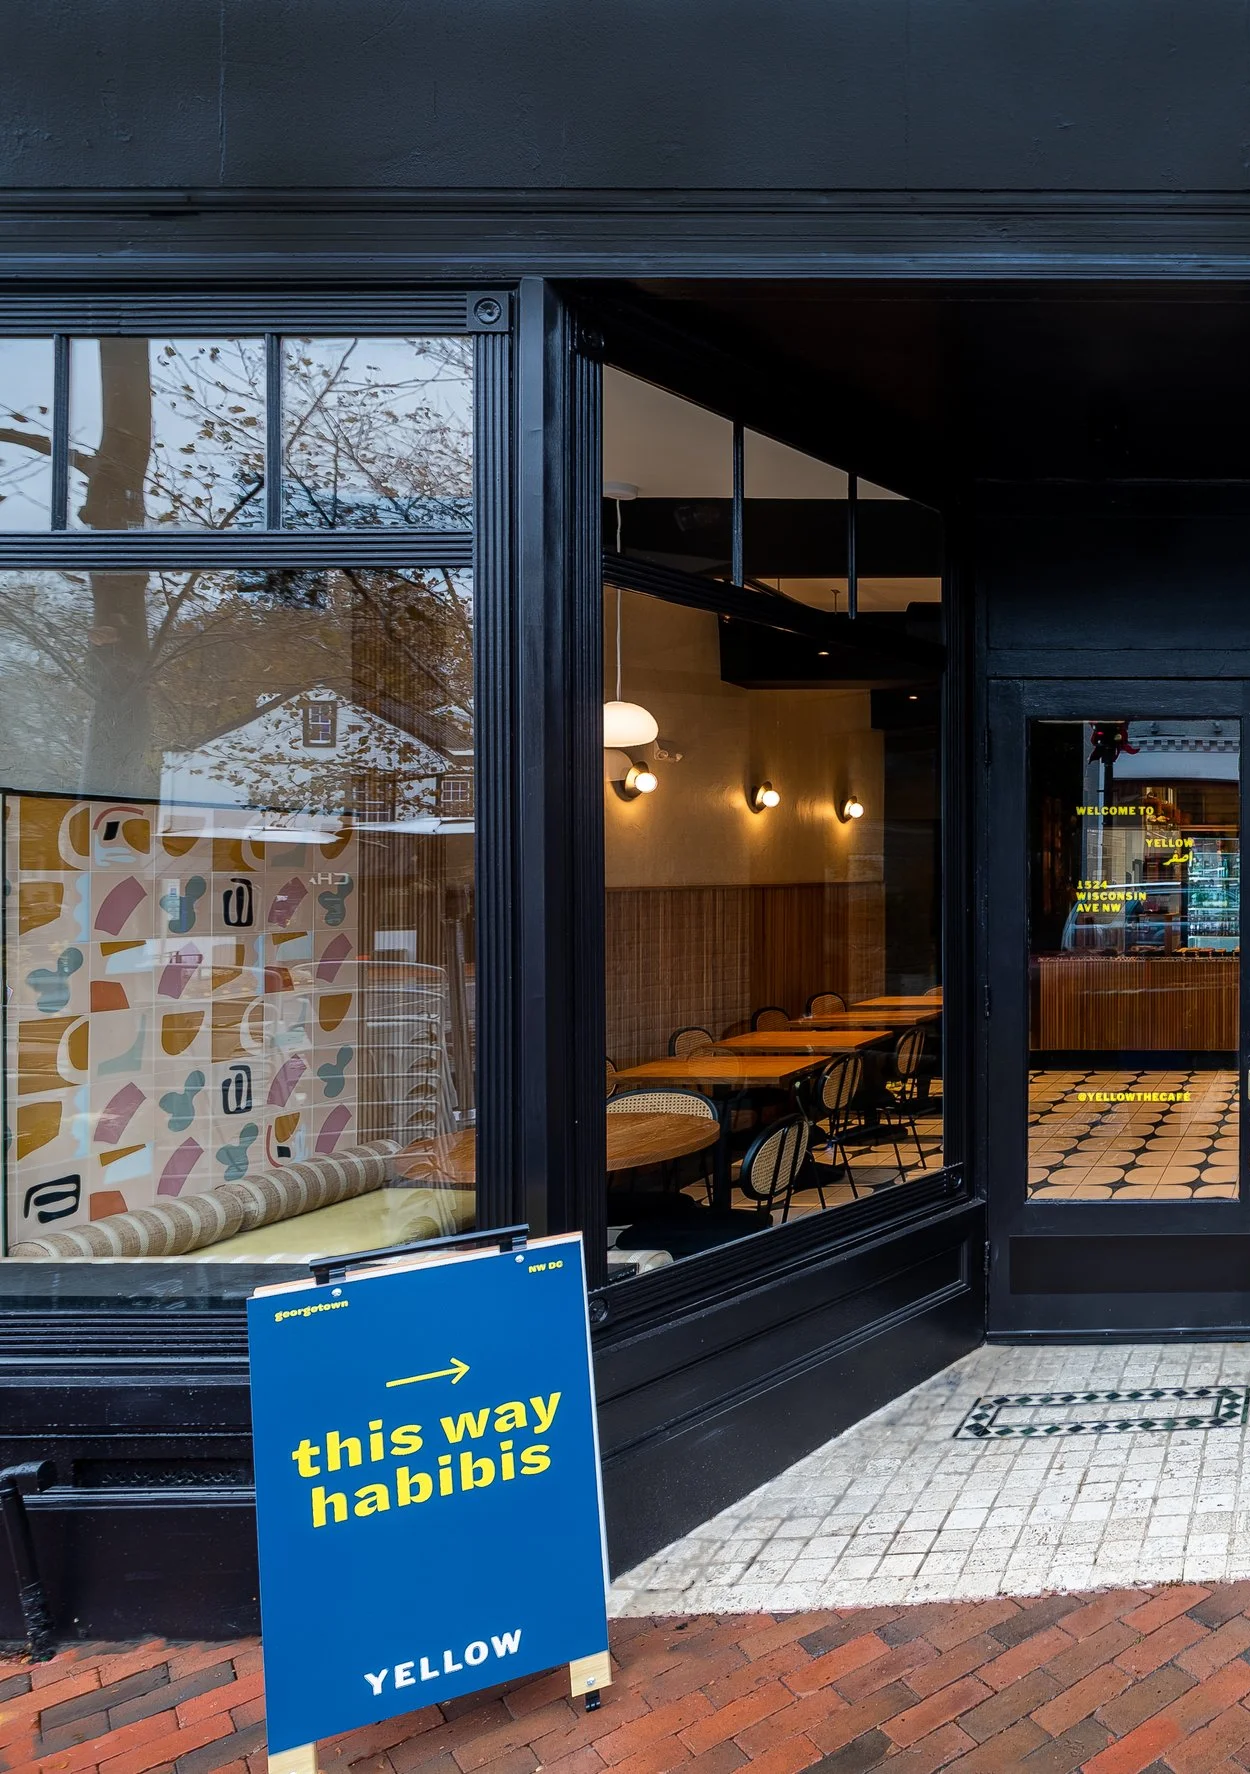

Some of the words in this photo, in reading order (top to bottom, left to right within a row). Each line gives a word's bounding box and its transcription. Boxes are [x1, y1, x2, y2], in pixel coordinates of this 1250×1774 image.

[1075, 806, 1136, 816] WELCOME
[1138, 806, 1155, 816] TO
[1145, 838, 1194, 848] YELLOW
[1076, 880, 1108, 890] 1524
[1075, 891, 1147, 901] WISCONSIN
[1076, 903, 1100, 913] AVE
[1101, 903, 1122, 913] NW
[528, 1263, 547, 1274] NW
[548, 1260, 564, 1270] DC
[274, 1300, 349, 1322] georgetown
[291, 1419, 423, 1479] this
[440, 1391, 562, 1444] way
[310, 1440, 552, 1529] habibis
[363, 1628, 523, 1697] YELLOW
